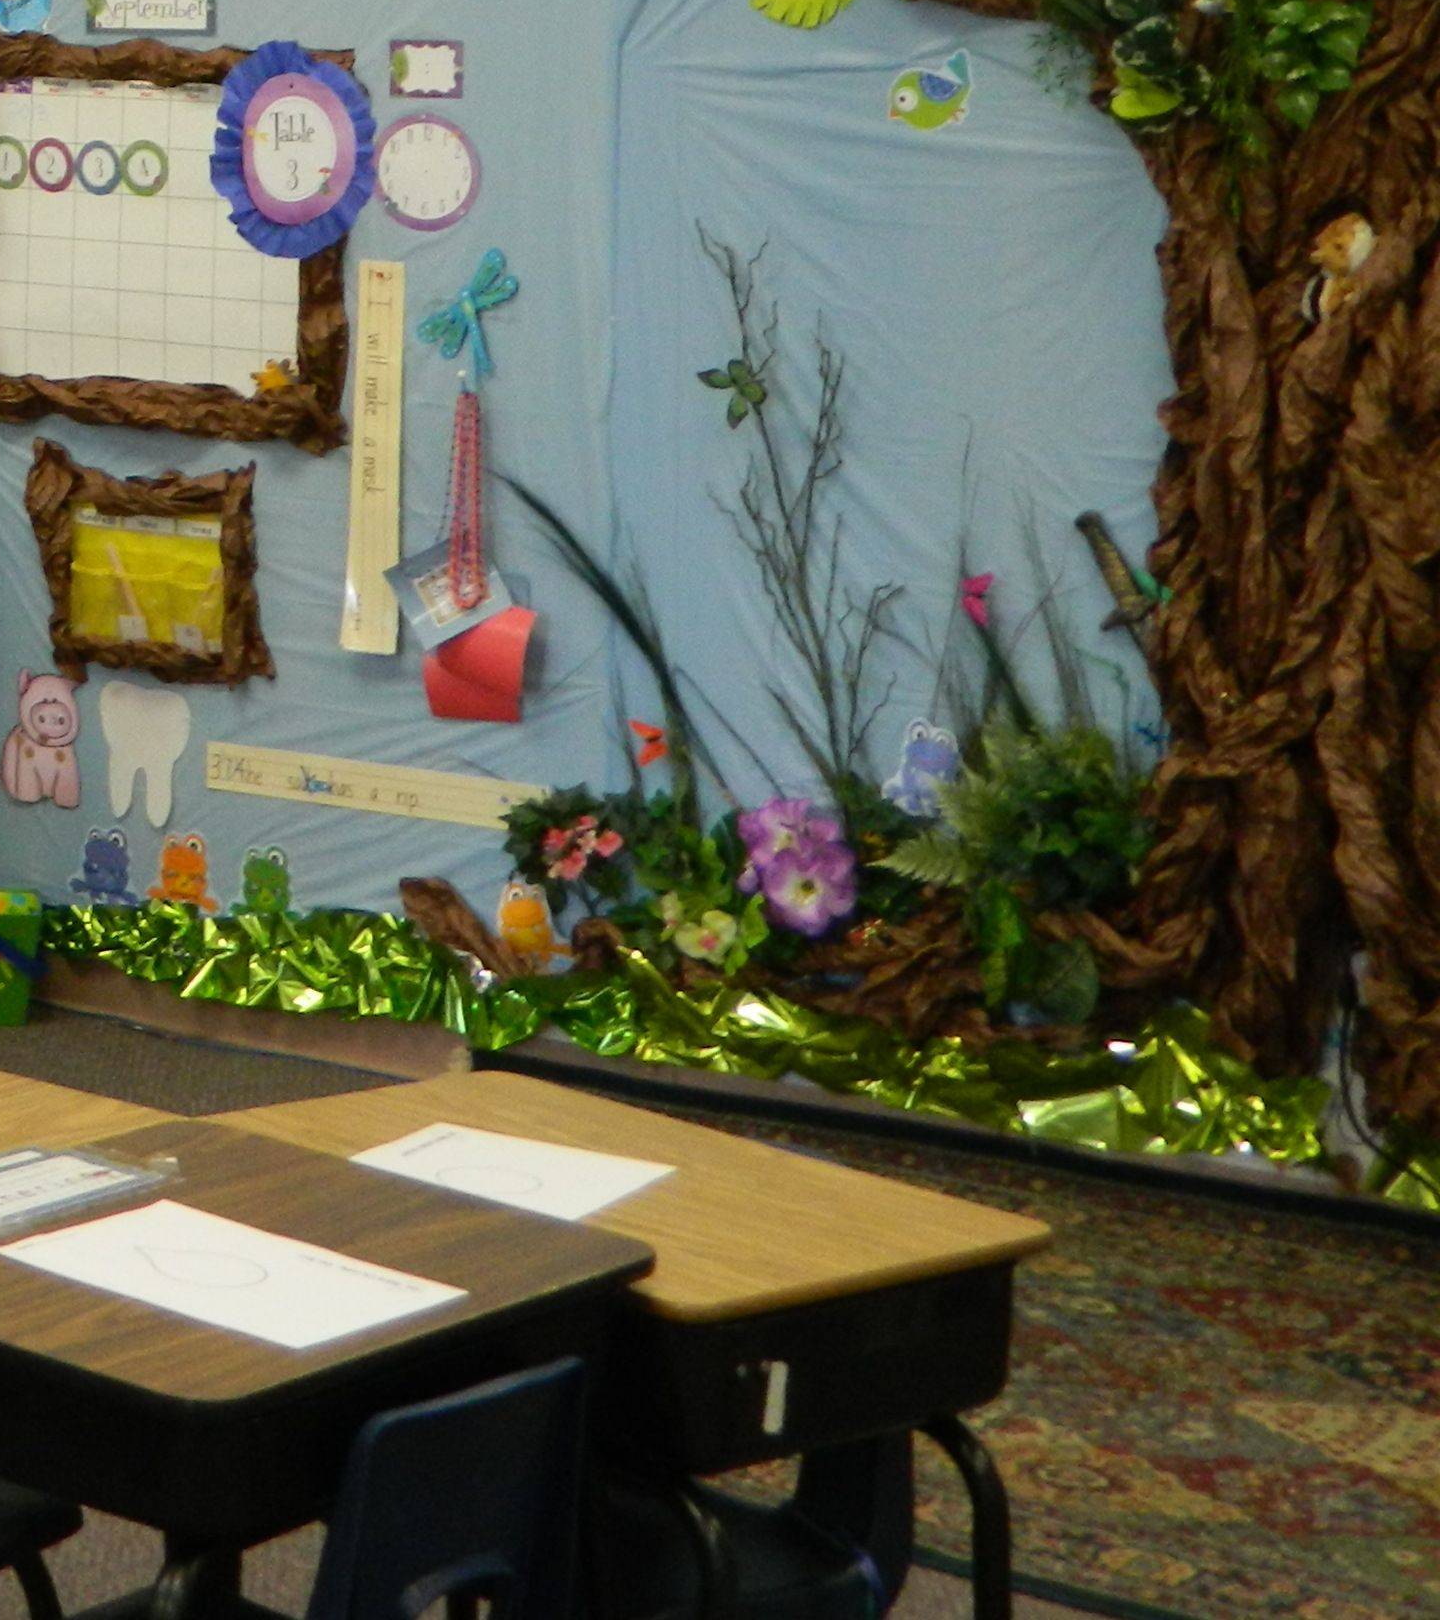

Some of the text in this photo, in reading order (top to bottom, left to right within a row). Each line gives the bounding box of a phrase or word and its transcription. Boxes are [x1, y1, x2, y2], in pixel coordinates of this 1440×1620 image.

[269, 112, 315, 151] Table
[46, 150, 56, 175] 2
[94, 157, 104, 178] 3
[287, 159, 298, 191] 3
